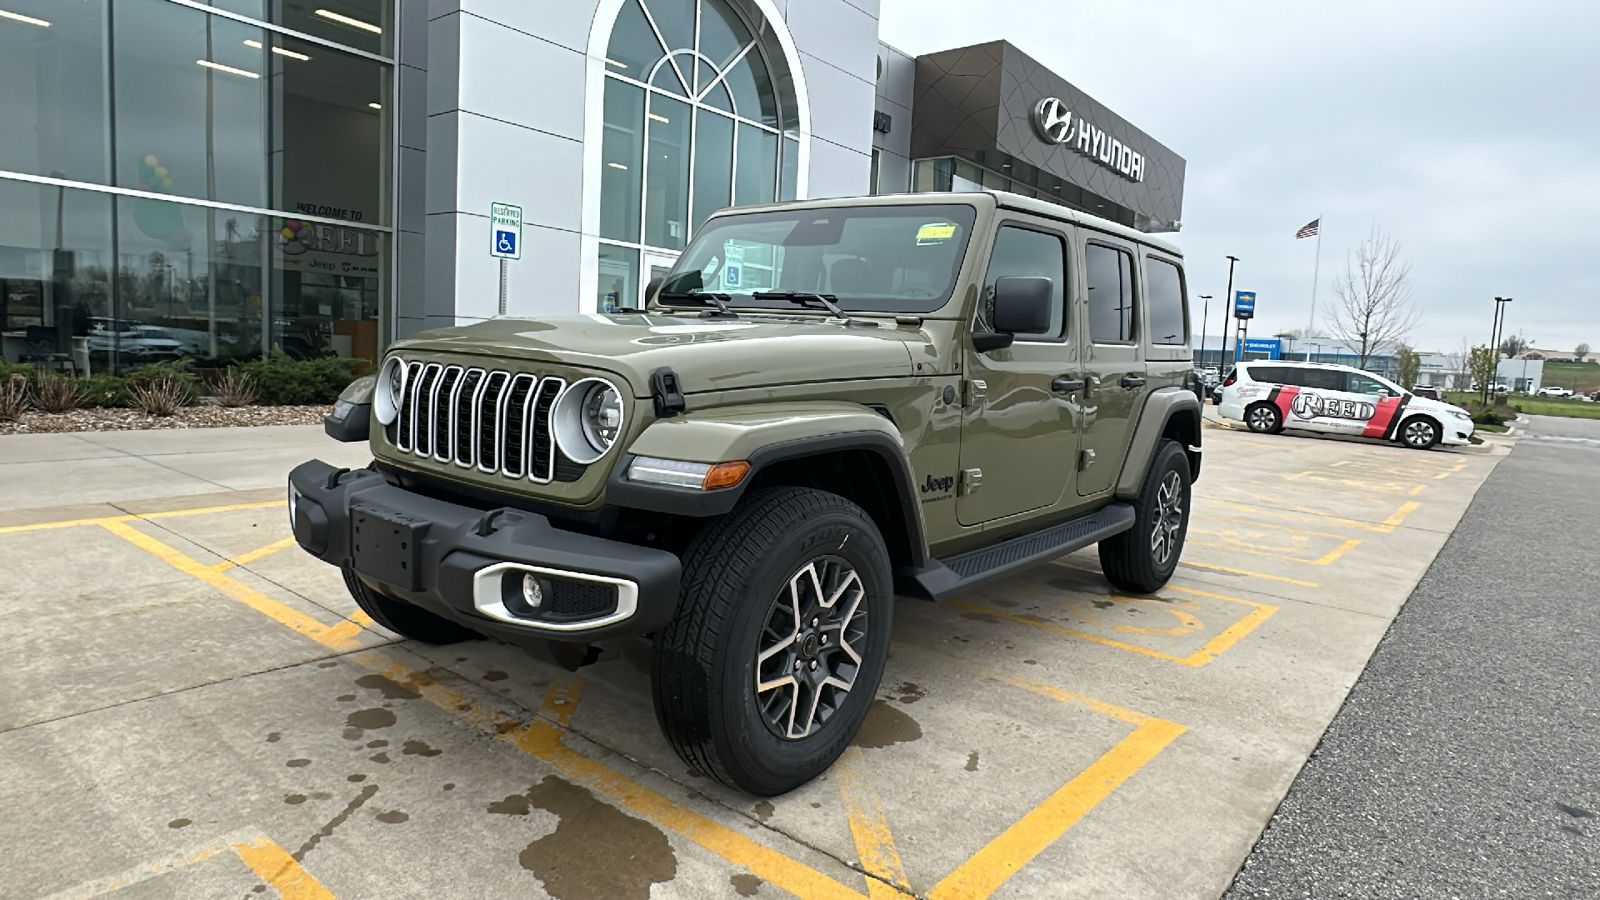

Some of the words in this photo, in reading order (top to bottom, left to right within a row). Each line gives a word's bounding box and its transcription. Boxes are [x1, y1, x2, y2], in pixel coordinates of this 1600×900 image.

[1077, 118, 1145, 182] HYUNDAI
[297, 203, 348, 219] WELCOME
[350, 211, 363, 220] TO
[493, 207, 520, 219] RESERVED
[493, 216, 520, 228] PARKING
[309, 259, 336, 271] Jeep
[1291, 391, 1375, 419] REED
[921, 474, 954, 493] Jeep
